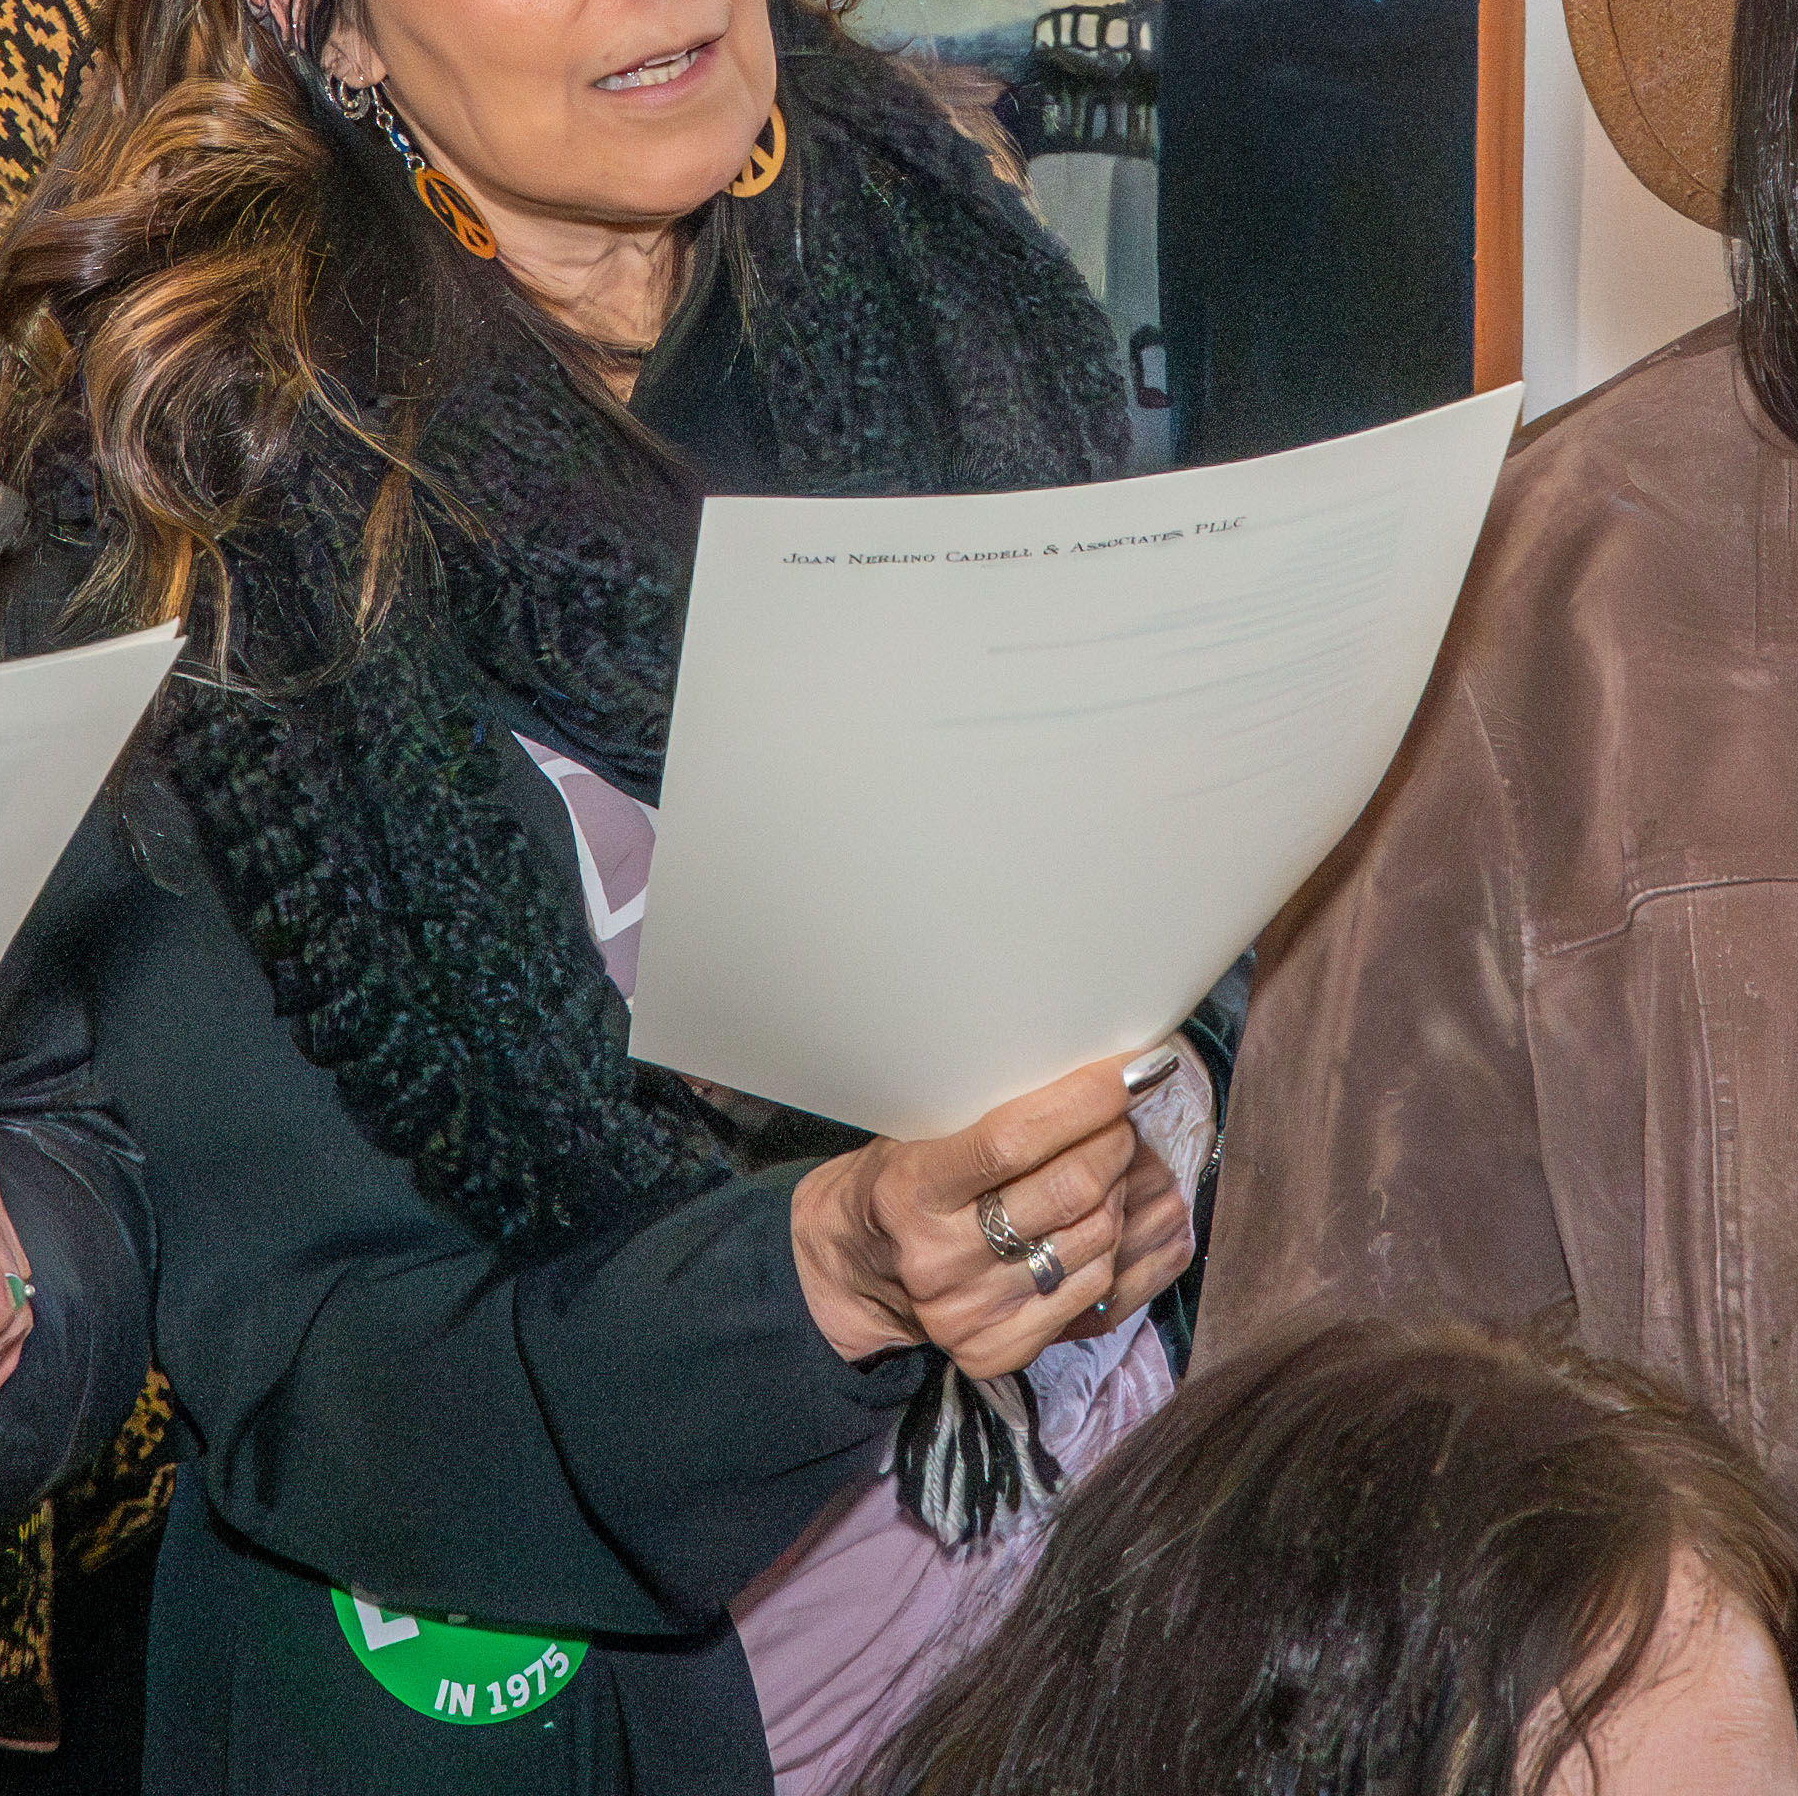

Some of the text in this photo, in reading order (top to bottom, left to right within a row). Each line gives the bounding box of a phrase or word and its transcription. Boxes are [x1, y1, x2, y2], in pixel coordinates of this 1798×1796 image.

[1043, 544, 1059, 556] &
[1195, 516, 1246, 536] PLLC
[434, 1642, 570, 1717] IN 1975
